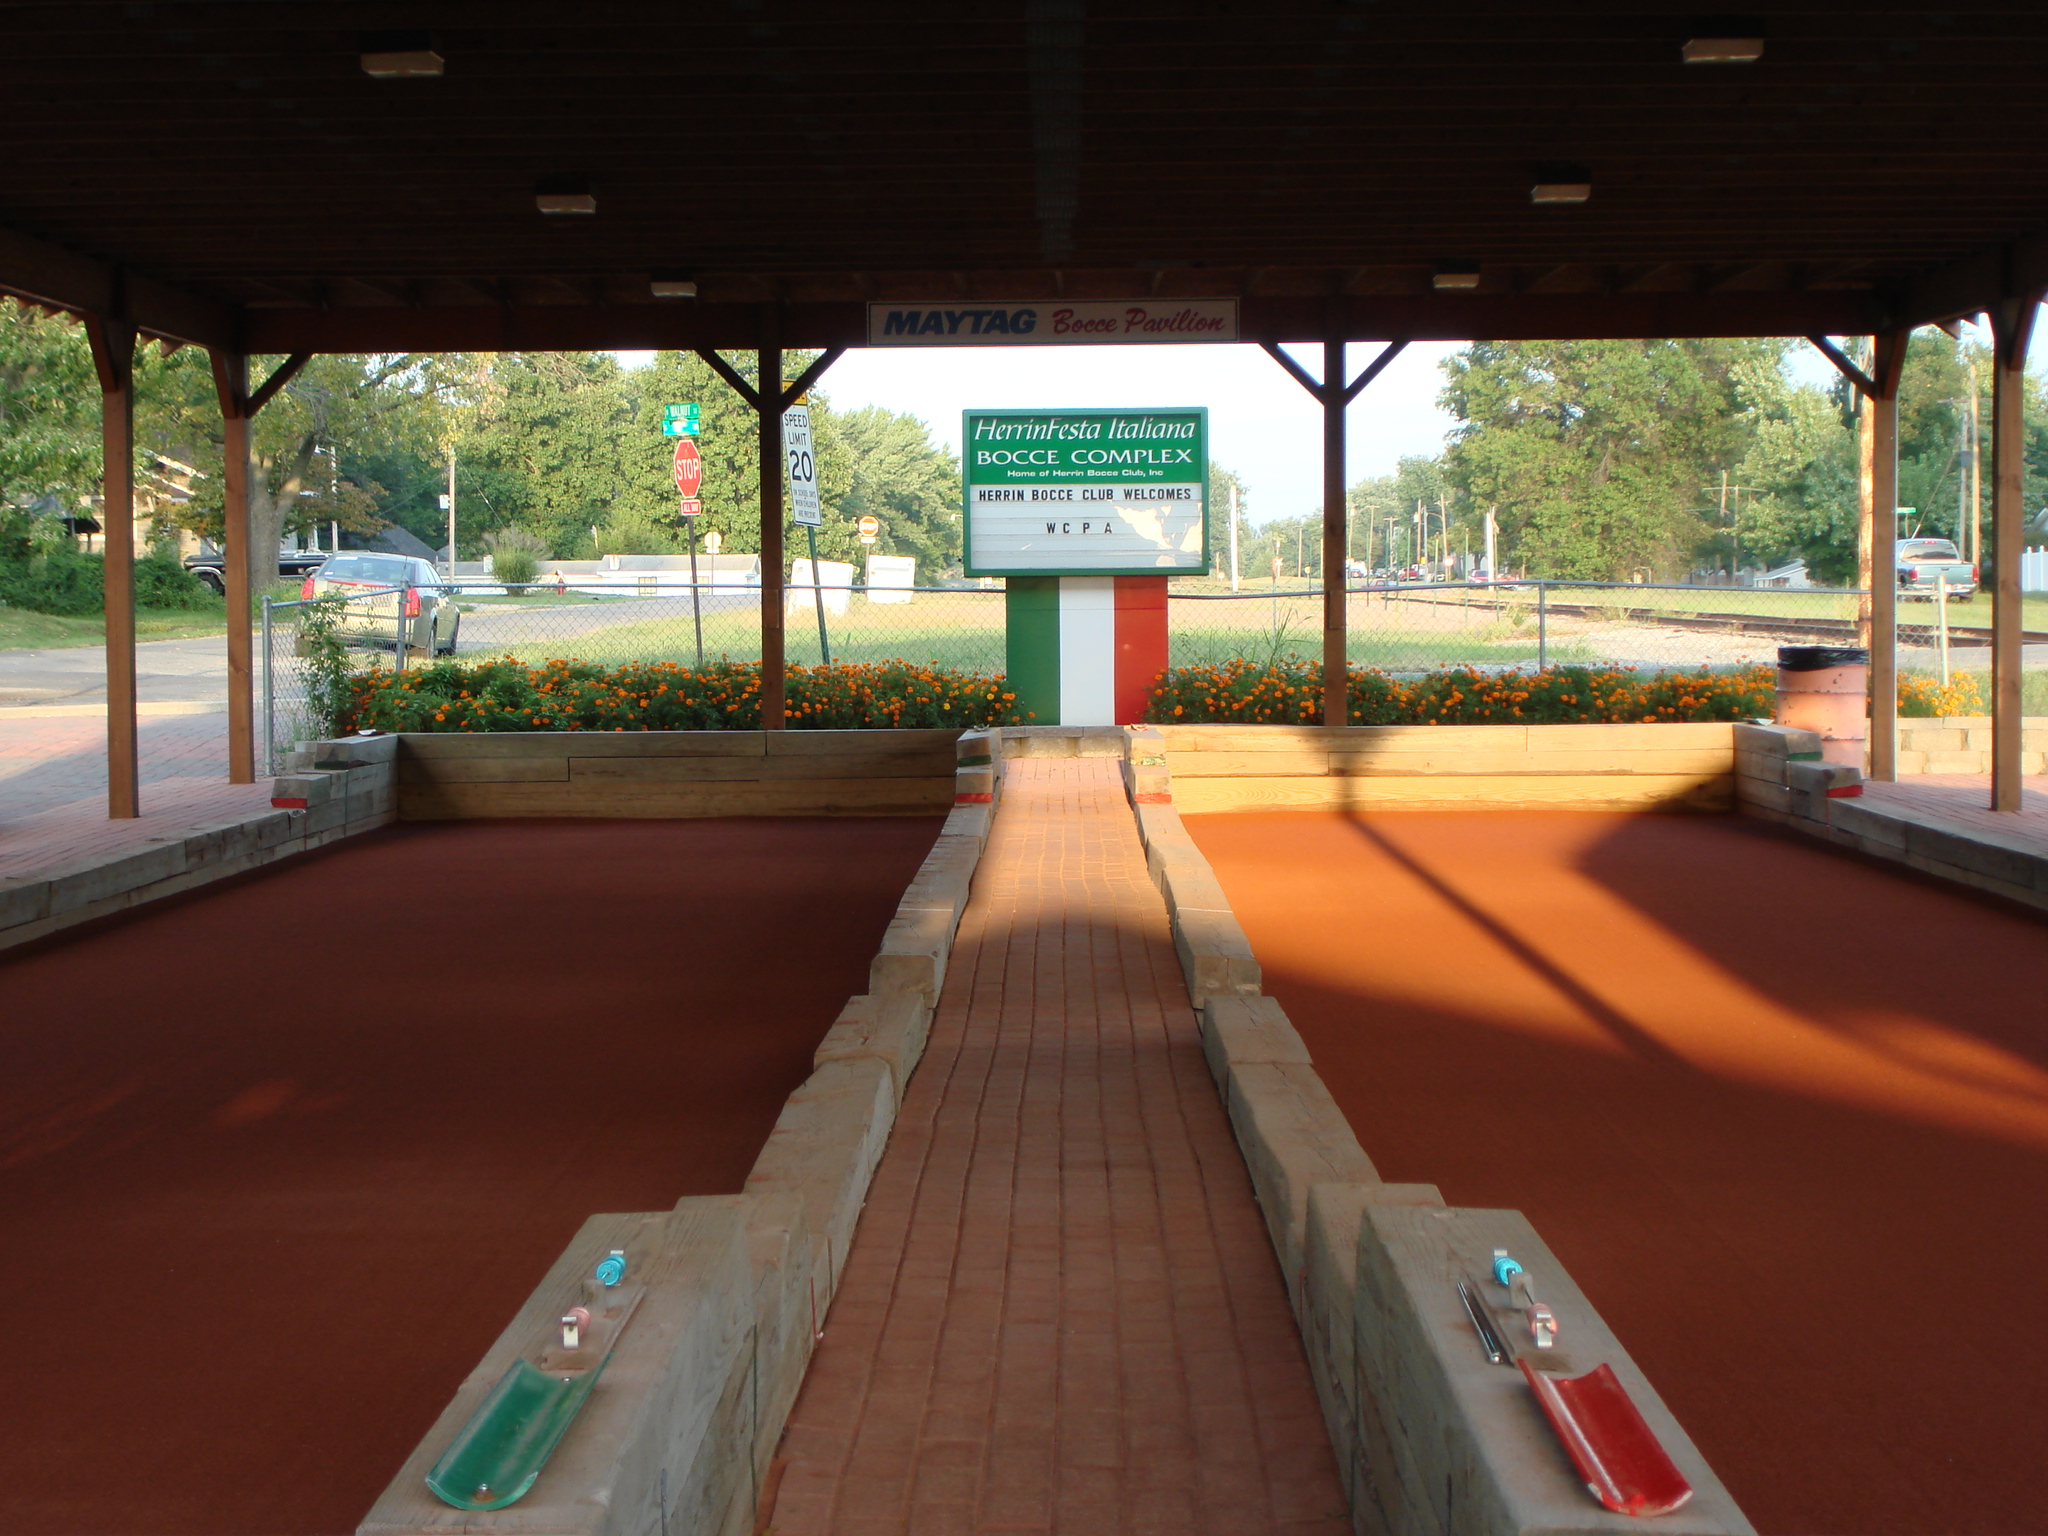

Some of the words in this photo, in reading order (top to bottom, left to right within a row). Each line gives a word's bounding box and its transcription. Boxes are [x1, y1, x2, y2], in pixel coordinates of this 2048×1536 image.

[884, 309, 1037, 335] MAYTAG
[1052, 308, 1118, 335] Bocce
[1124, 307, 1225, 334] Pavilion
[784, 413, 808, 428] SPEED
[974, 417, 1102, 440] HerrinFesta
[1107, 416, 1196, 439] Italiana
[788, 432, 807, 446] LIMIT
[977, 449, 1060, 465] BOCCE
[1071, 448, 1193, 464] COMPLEX
[676, 458, 699, 481] STOP
[789, 449, 812, 482] 20
[1053, 469, 1084, 477] Herrin
[1087, 469, 1119, 477] Bocce
[1122, 469, 1146, 478] Club,
[979, 489, 1025, 501] HERRIN
[1031, 489, 1073, 501] BOCCE
[1082, 489, 1114, 500] CLUB
[1124, 488, 1191, 500] WELCOMES
